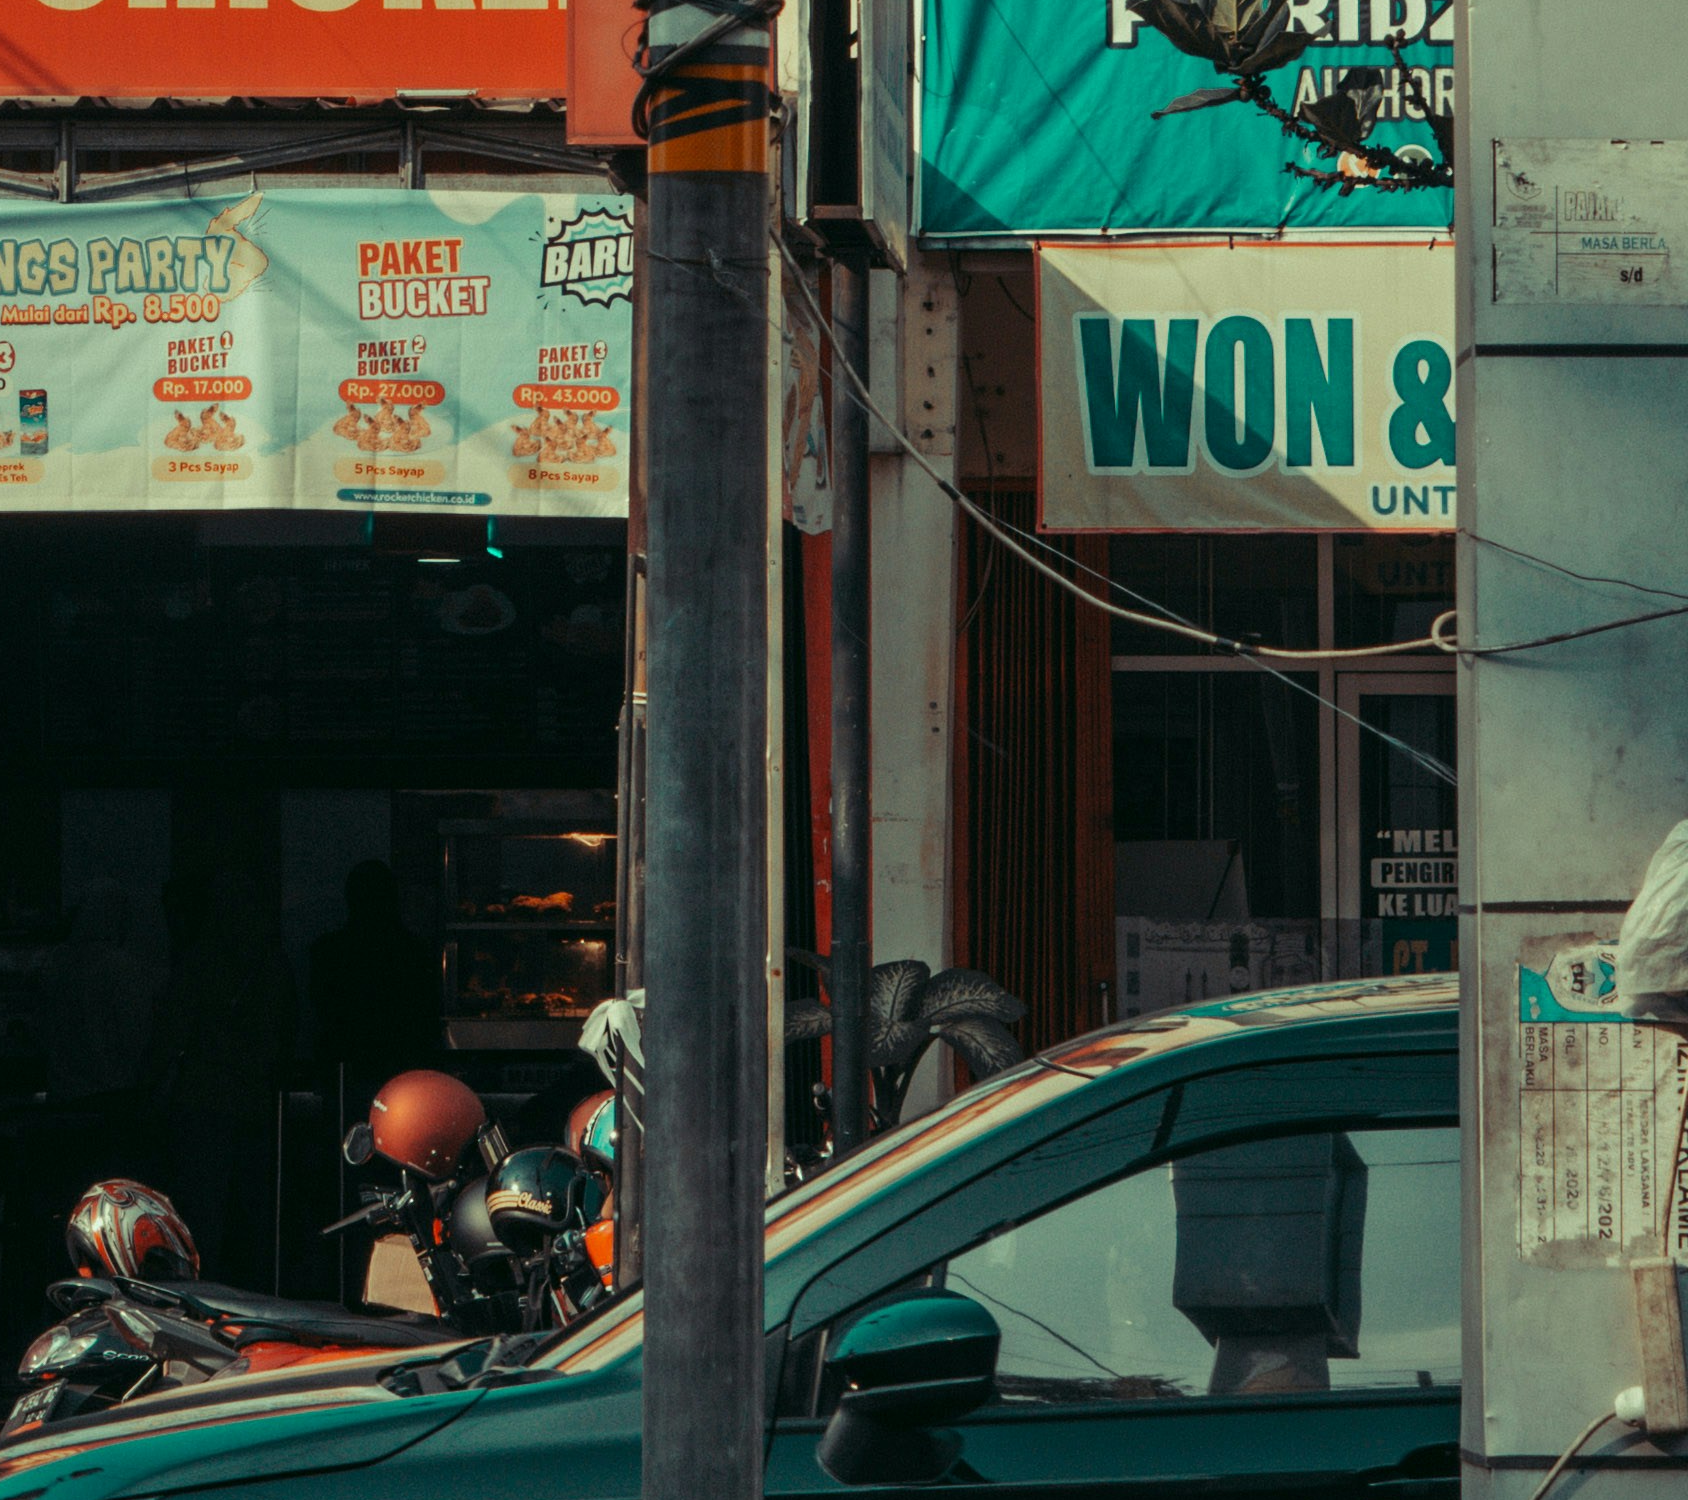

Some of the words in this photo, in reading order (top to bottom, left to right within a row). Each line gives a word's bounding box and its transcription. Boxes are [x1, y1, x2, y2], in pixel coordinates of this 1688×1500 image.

[1581, 237, 1618, 250] MASA
[87, 236, 235, 295] PARTY
[359, 239, 462, 276] PAKET
[1620, 267, 1643, 283] s/d
[359, 276, 490, 320] BUCKET
[1, 304, 50, 325] Mulai
[54, 303, 89, 324] dari
[93, 296, 136, 328] Rp.
[143, 293, 219, 322] 8.500
[167, 336, 215, 356] PAKET
[357, 340, 407, 359] PAKET
[413, 336, 426, 354] 2
[538, 345, 588, 364] PAKET
[594, 341, 608, 360] 3
[167, 352, 228, 374] BUCKET
[357, 356, 421, 376] BUCKET
[538, 361, 602, 382] BUCKET
[163, 382, 190, 396] Rp.
[194, 380, 244, 394] 17.000
[347, 383, 374, 398] Rp.
[378, 383, 436, 398] 27.000
[521, 388, 549, 404] Rp.
[552, 388, 612, 403] 43.000
[1080, 316, 1354, 470] WON
[1389, 340, 1456, 469] &
[11, 474, 28, 483] Teh
[168, 461, 178, 473] 3
[181, 461, 205, 473] Pcs
[208, 460, 239, 476] Sayap
[355, 464, 363, 475] 5
[366, 465, 386, 476] Pcs
[389, 465, 425, 477] Sayap
[528, 469, 537, 480] 8
[540, 470, 560, 481] Pcs
[563, 471, 599, 483] Sayap
[1381, 862, 1454, 884] PENGIR
[1378, 893, 1408, 917] KE
[1538, 1026, 1549, 1062] MASA
[1525, 1026, 1535, 1086] BERLAKU
[1641, 1149, 1650, 1208] LAKSANA
[517, 1191, 553, 1215] Classic
